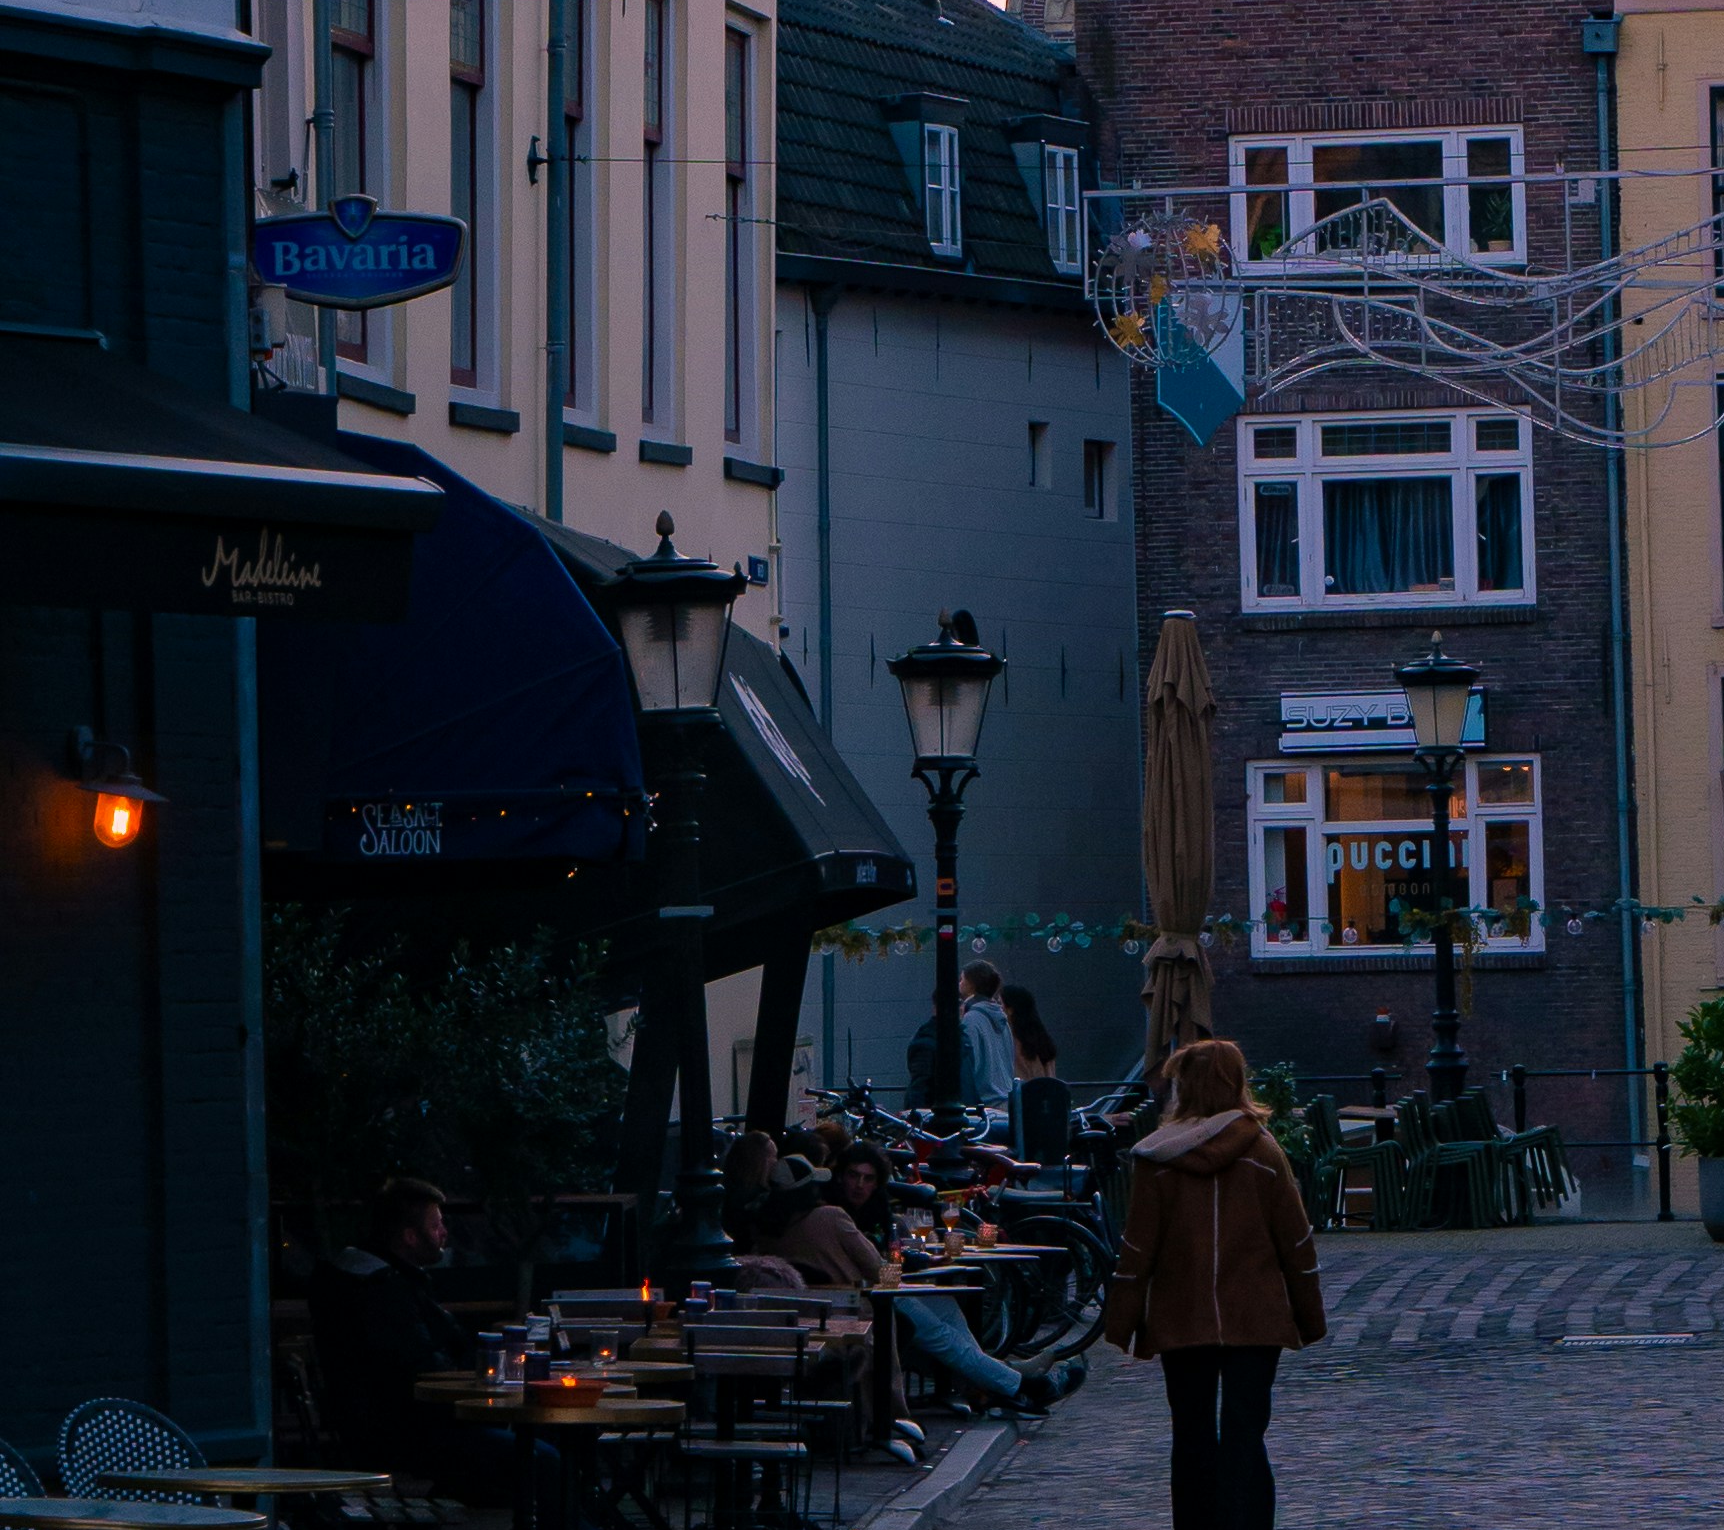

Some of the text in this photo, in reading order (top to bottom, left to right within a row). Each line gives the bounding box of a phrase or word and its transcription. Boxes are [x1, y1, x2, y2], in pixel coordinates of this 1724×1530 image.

[272, 236, 437, 276] Bavaria
[202, 525, 322, 590] Madeleine
[231, 589, 295, 606] BAR-BISTRO
[1285, 703, 1378, 728] SUZY
[360, 829, 441, 856] SALOON
